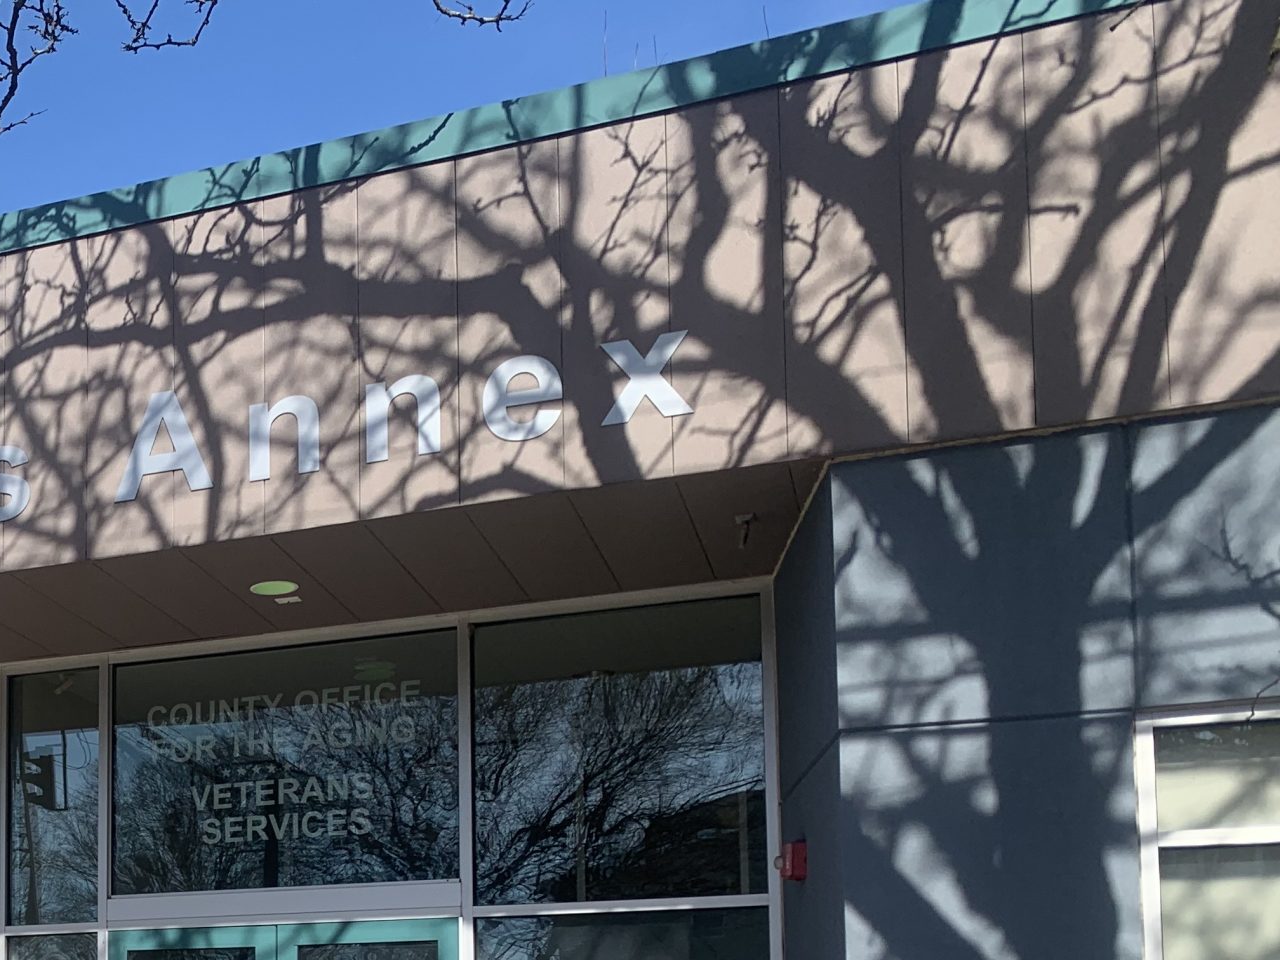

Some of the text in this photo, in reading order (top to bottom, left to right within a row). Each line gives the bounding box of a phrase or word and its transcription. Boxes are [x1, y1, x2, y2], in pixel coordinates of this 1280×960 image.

[114, 329, 695, 503] Annex
[147, 680, 421, 727] COUNTY OFFICE
[151, 715, 417, 763] FOR THE AGING
[190, 772, 374, 812] VETERANS
[201, 807, 373, 844] SERVICES
